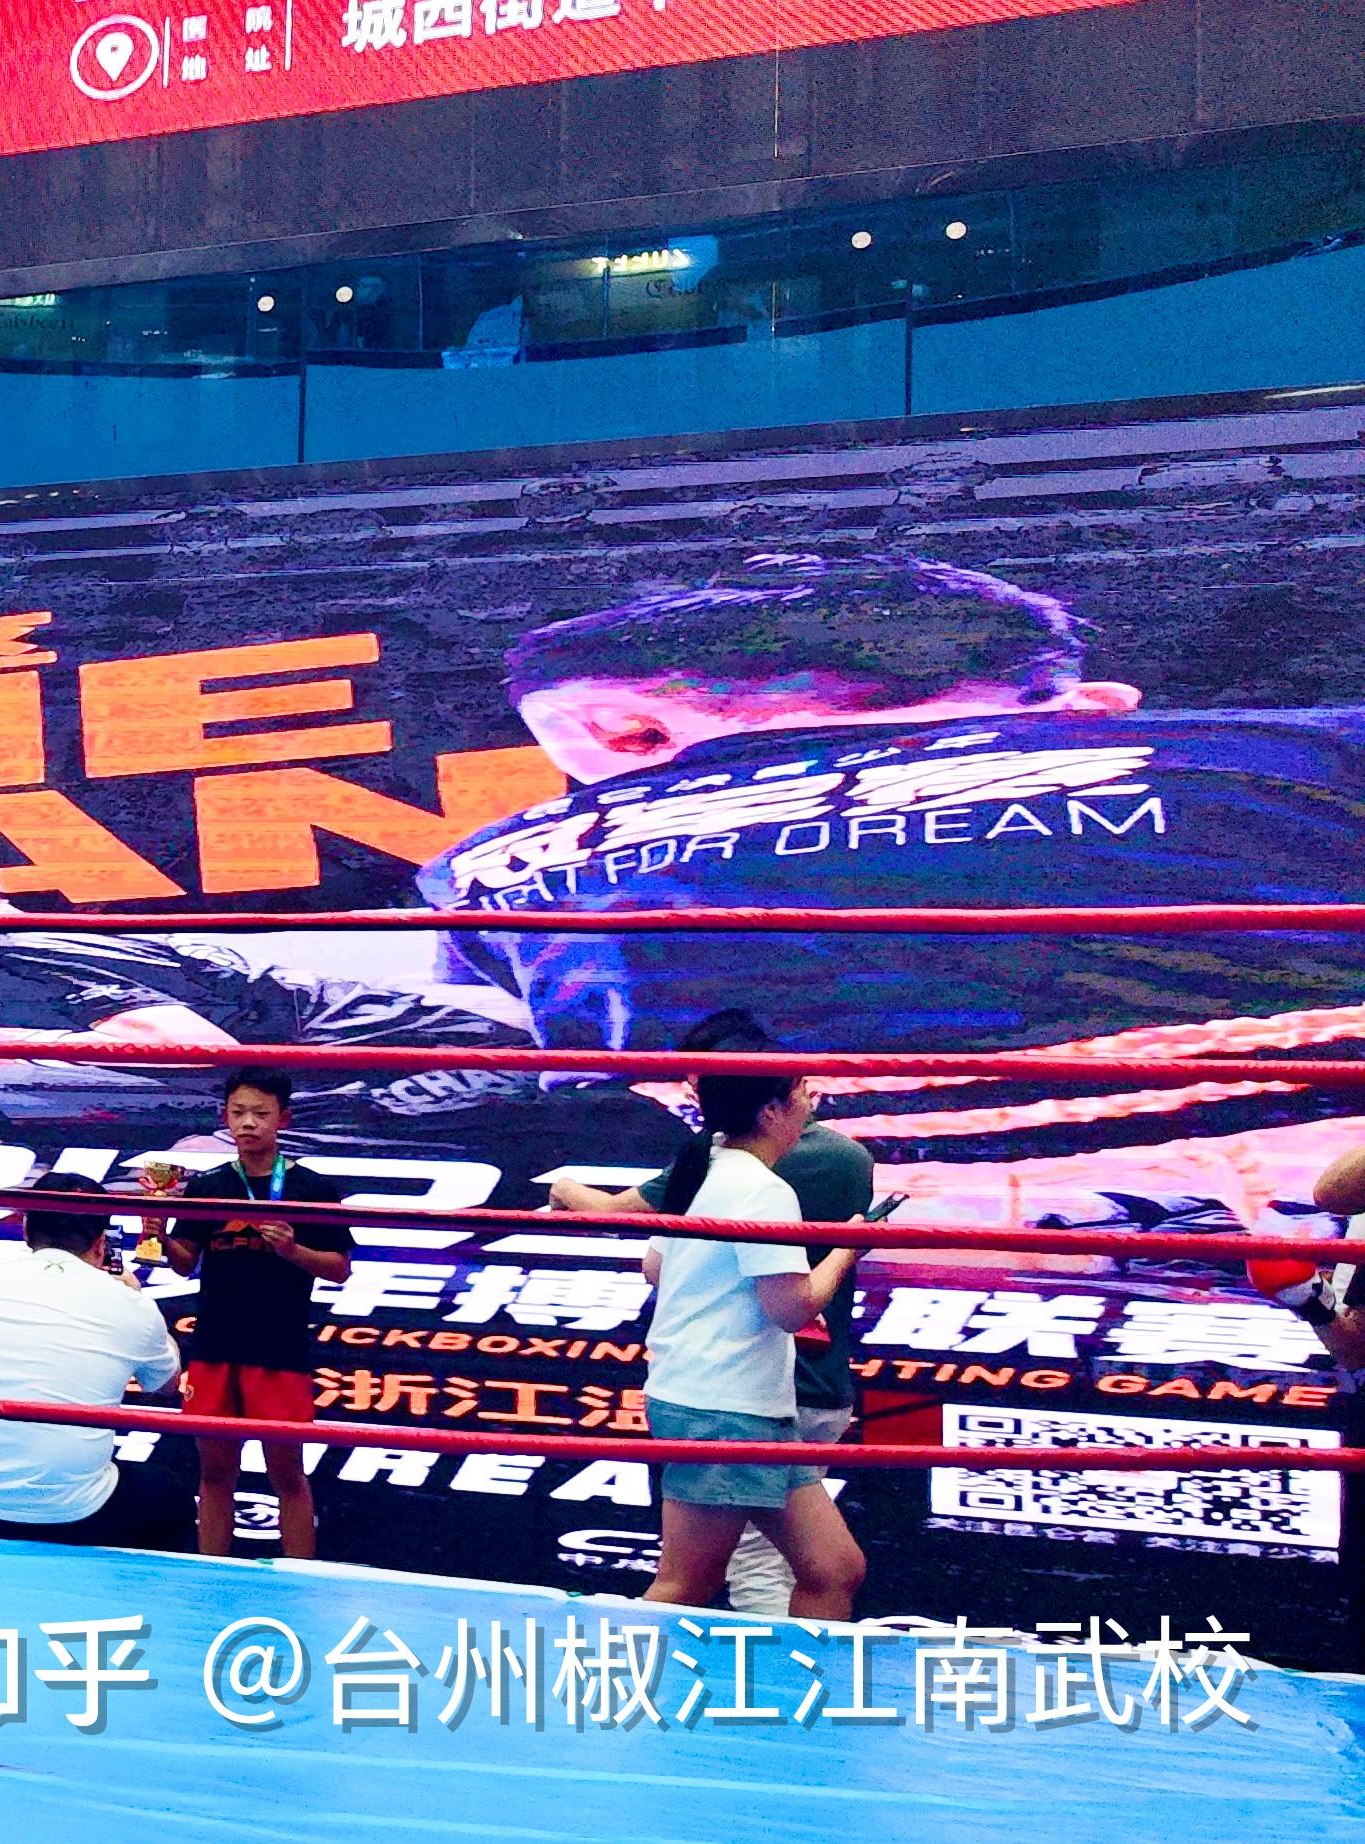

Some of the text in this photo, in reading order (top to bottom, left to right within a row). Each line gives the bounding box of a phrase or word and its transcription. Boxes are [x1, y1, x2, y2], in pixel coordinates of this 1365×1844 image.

[603, 831, 741, 885] FOR
[774, 797, 1167, 856] DREAM
[307, 1321, 655, 1362] ICKBOXIN
[1095, 1372, 1339, 1409] GAME
